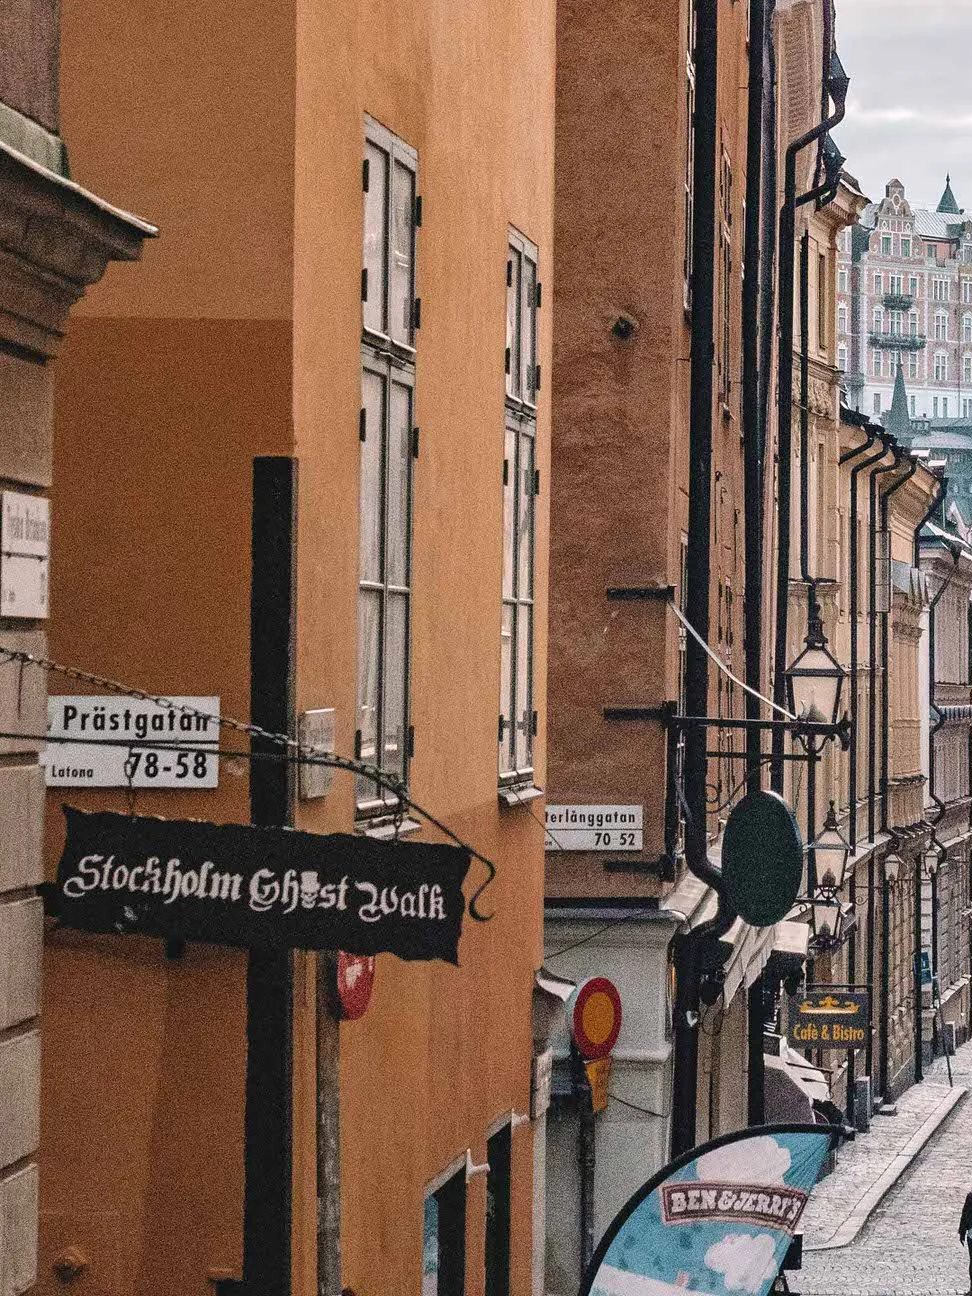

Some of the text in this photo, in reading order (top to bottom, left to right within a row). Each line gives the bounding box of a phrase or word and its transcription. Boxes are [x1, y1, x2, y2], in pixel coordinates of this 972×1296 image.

[63, 704, 209, 739] Prästgatan
[51, 765, 94, 779] Latona
[127, 752, 208, 779] 78-58
[63, 853, 242, 905] Stockholm
[354, 879, 448, 924] Walk
[821, 1024, 830, 1041] &
[832, 1024, 865, 1041] Bistro
